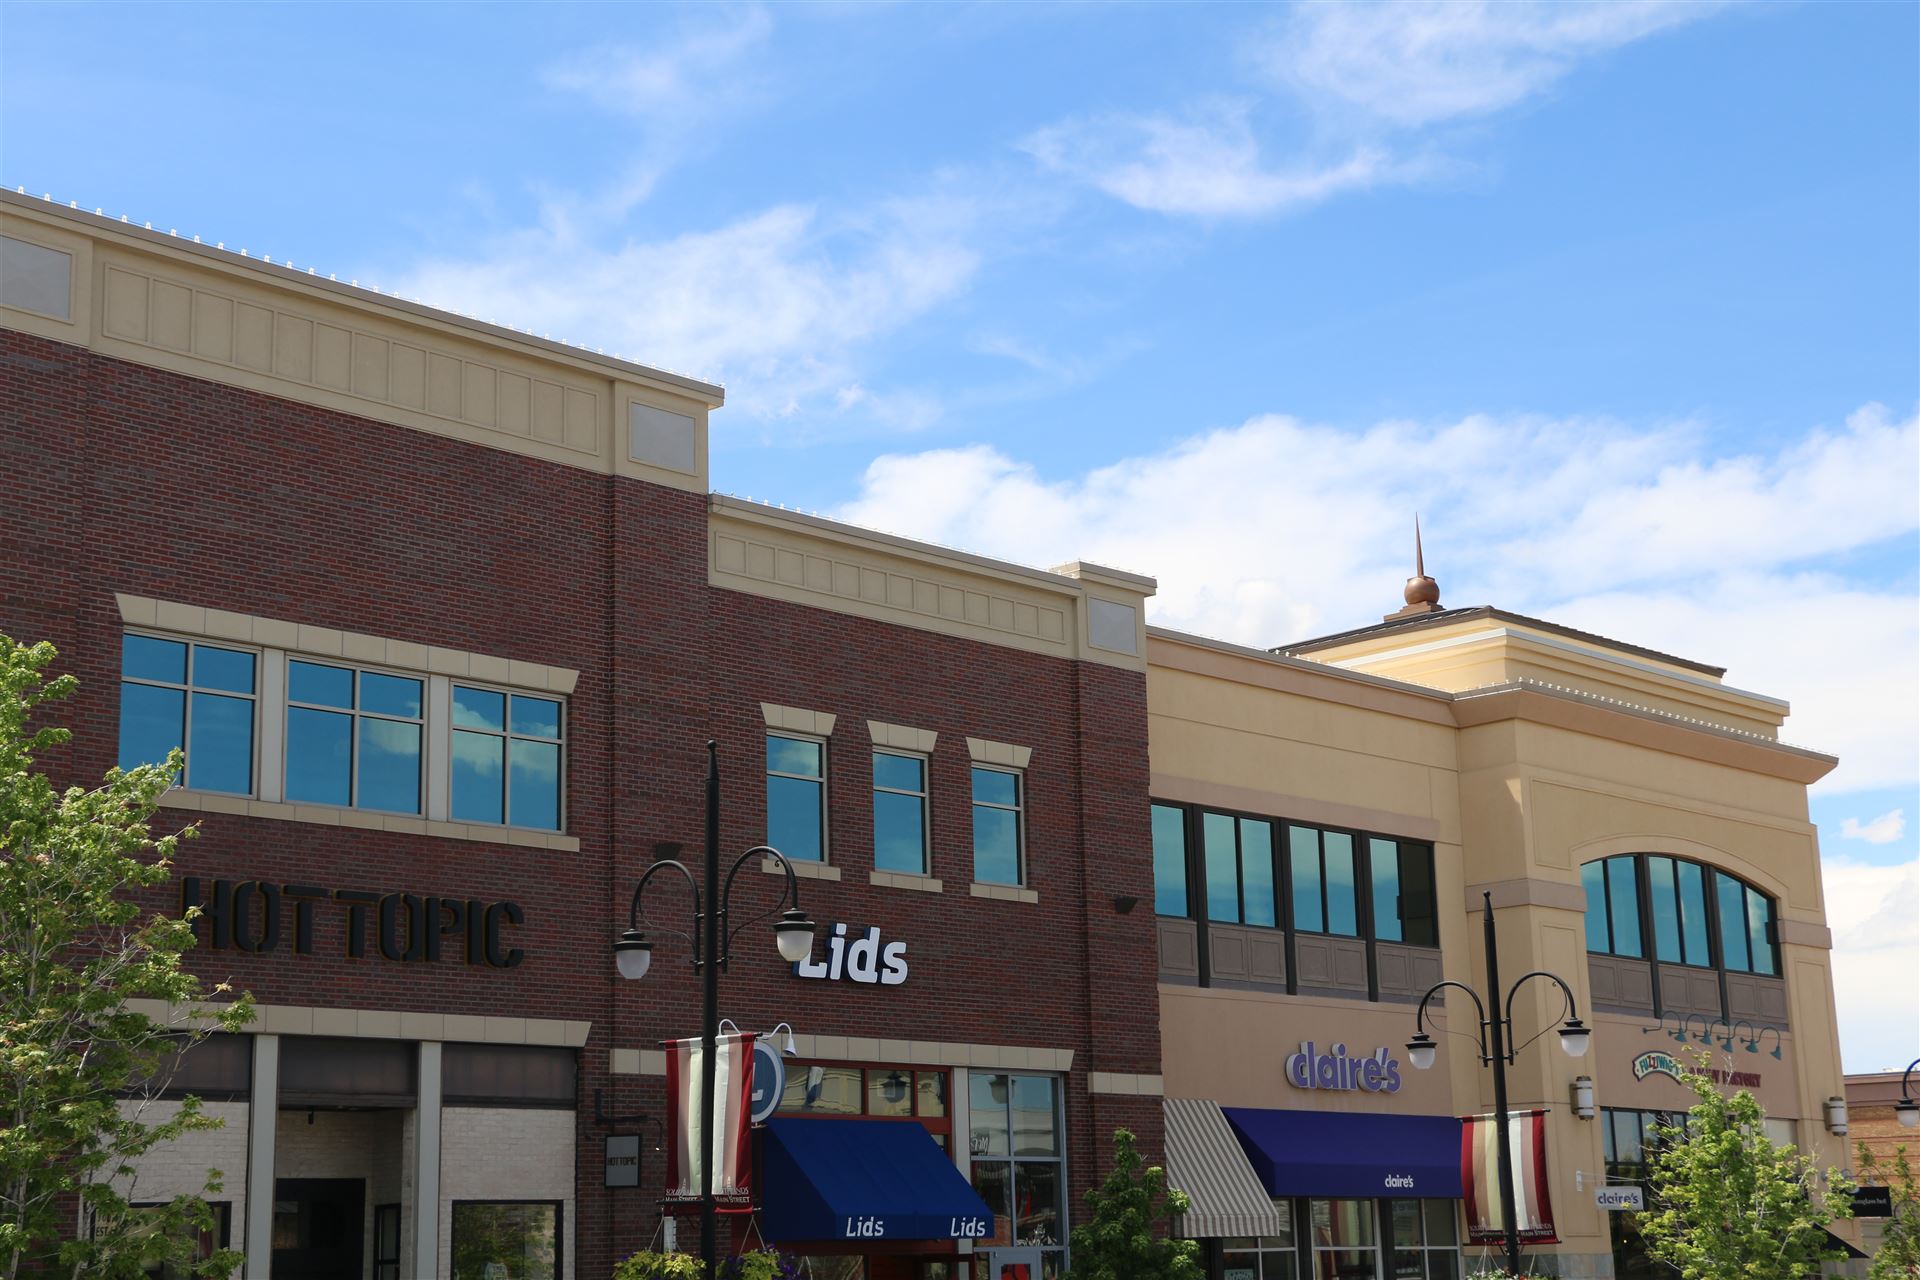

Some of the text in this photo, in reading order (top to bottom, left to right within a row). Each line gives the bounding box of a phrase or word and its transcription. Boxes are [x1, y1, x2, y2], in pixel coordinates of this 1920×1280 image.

[181, 876, 525, 969] HOT TOPIC
[794, 922, 909, 985] Lids
[1286, 1040, 1401, 1093] claire's
[1384, 1174, 1414, 1188] claire's
[1598, 1192, 1639, 1204] claire's
[846, 1216, 884, 1237] Lids
[950, 1217, 986, 1237] Lids
